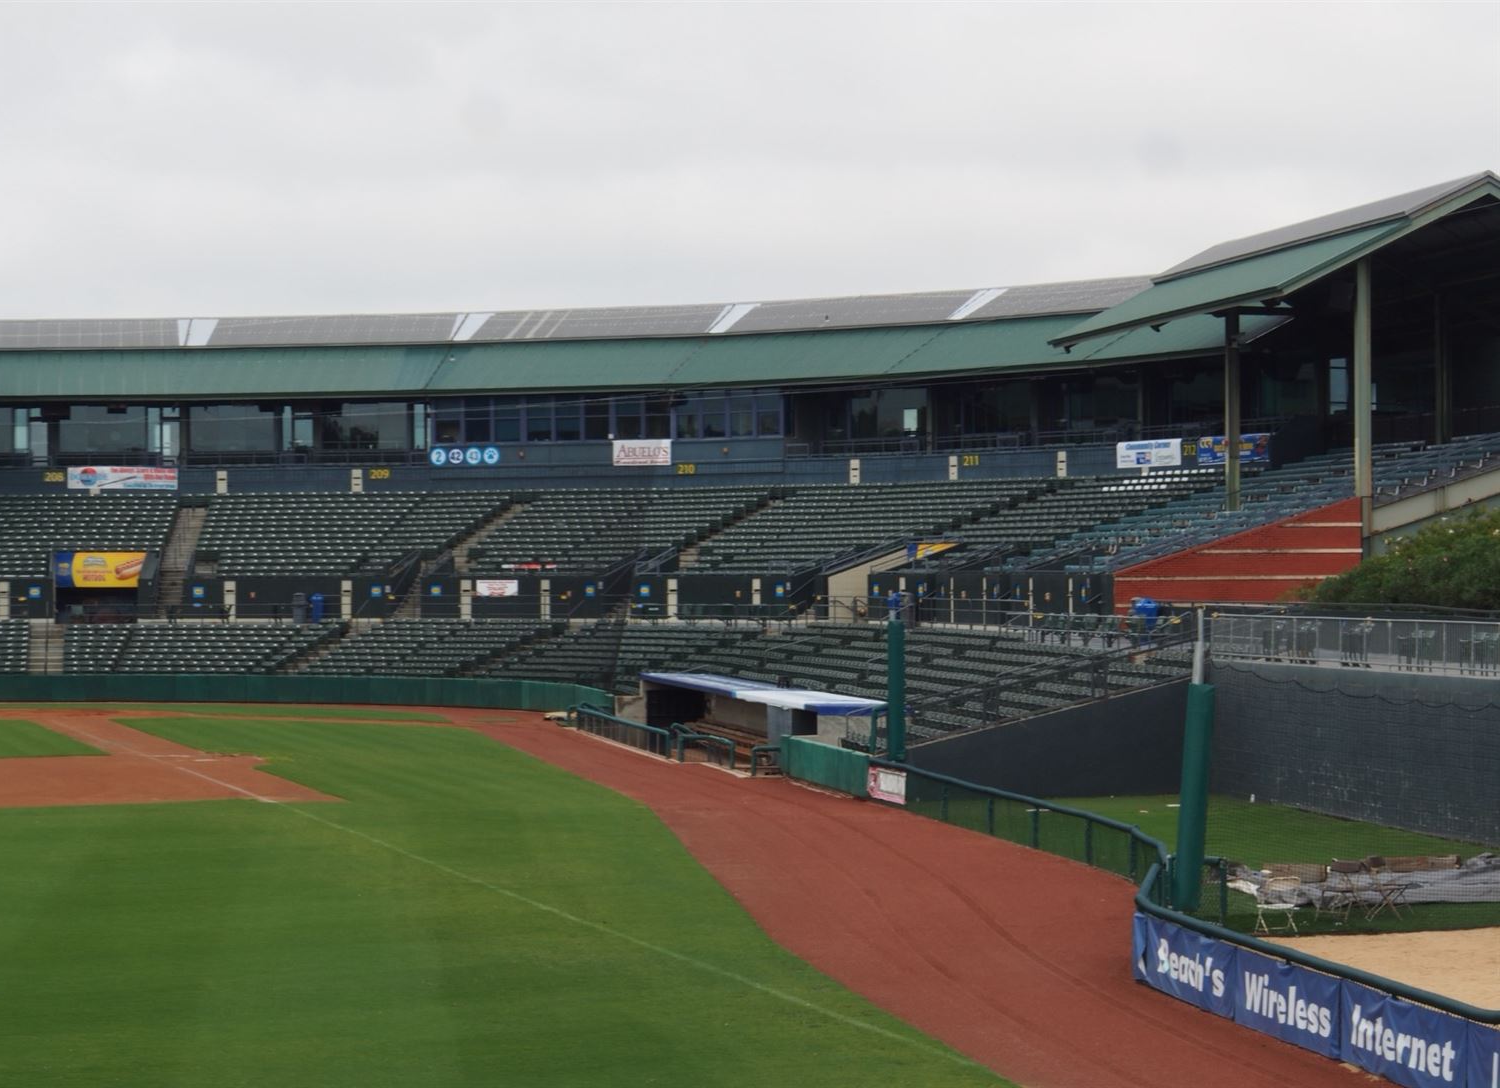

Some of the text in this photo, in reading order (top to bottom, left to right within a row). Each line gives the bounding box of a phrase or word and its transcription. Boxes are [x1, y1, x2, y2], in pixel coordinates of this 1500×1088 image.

[963, 456, 978, 465] 211
[370, 469, 389, 479] 209
[677, 464, 695, 474] 210
[1157, 938, 1225, 997] Beach's
[1244, 971, 1331, 1038] Wireless
[1352, 1005, 1456, 1081] Internet
